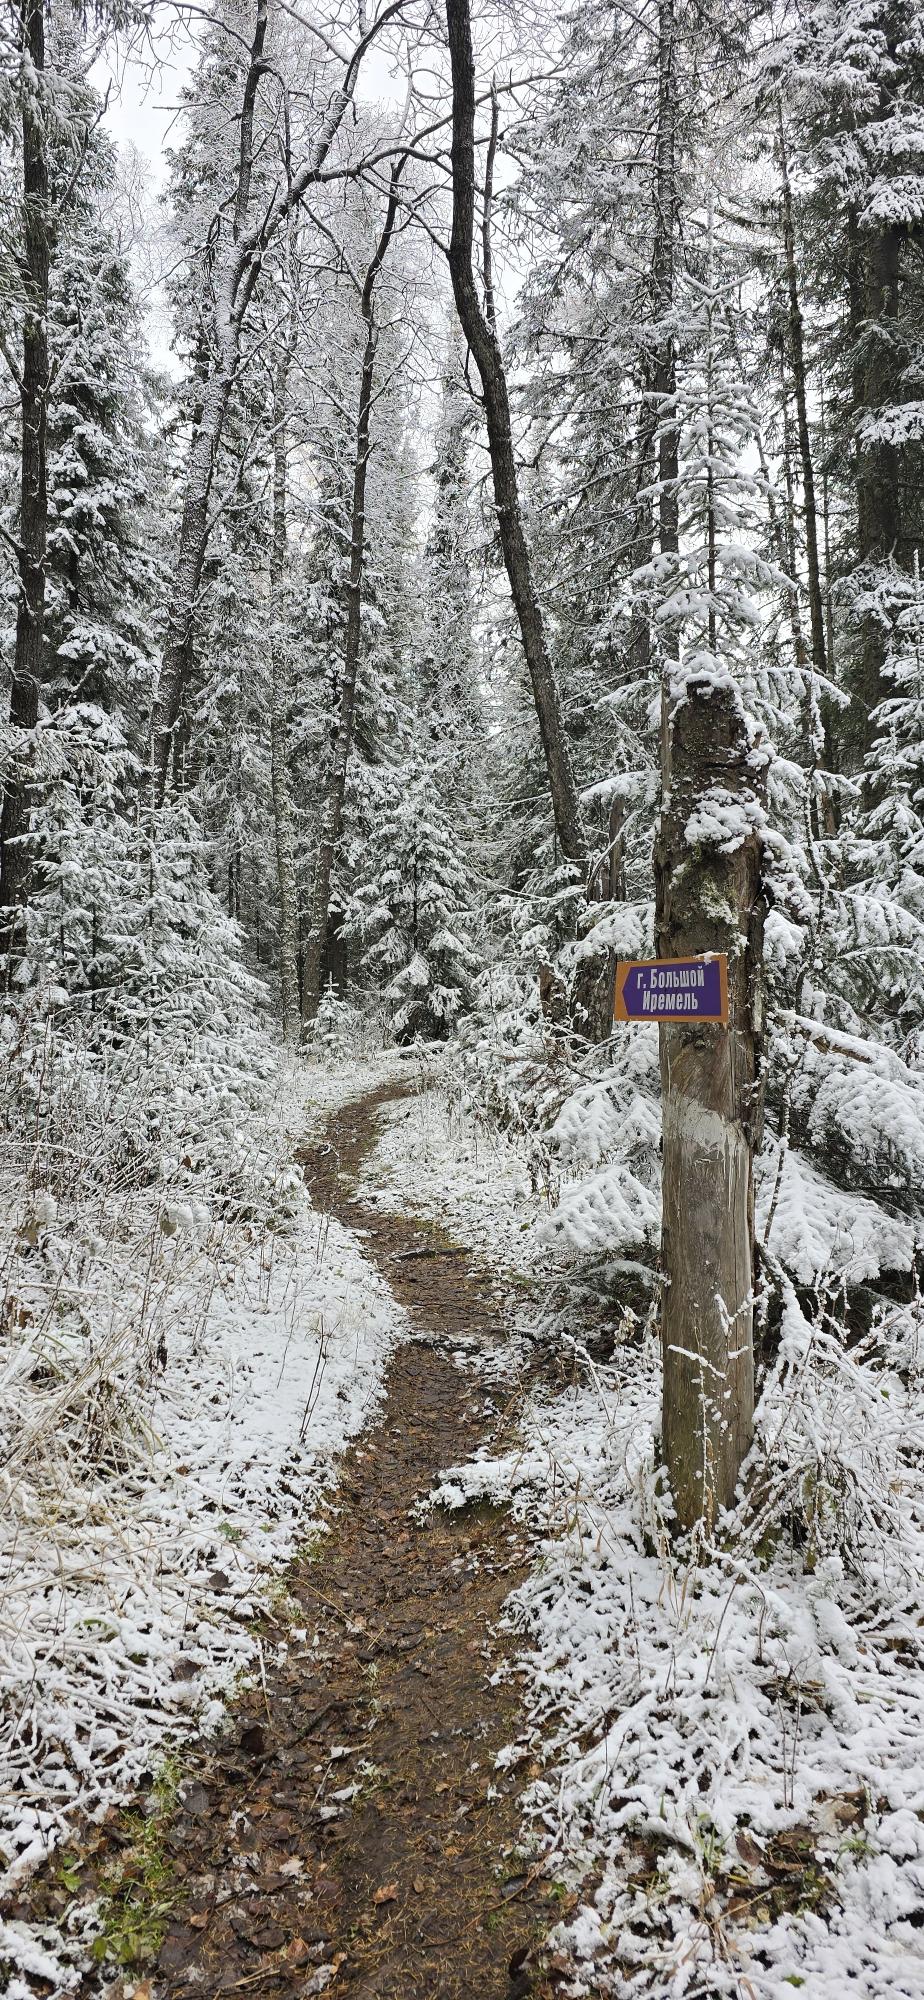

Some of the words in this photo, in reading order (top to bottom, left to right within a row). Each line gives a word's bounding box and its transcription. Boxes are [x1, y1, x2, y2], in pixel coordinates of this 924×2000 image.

[636, 972, 647, 990] г.
[650, 965, 705, 989] Большой
[642, 990, 699, 1013] Иремель
